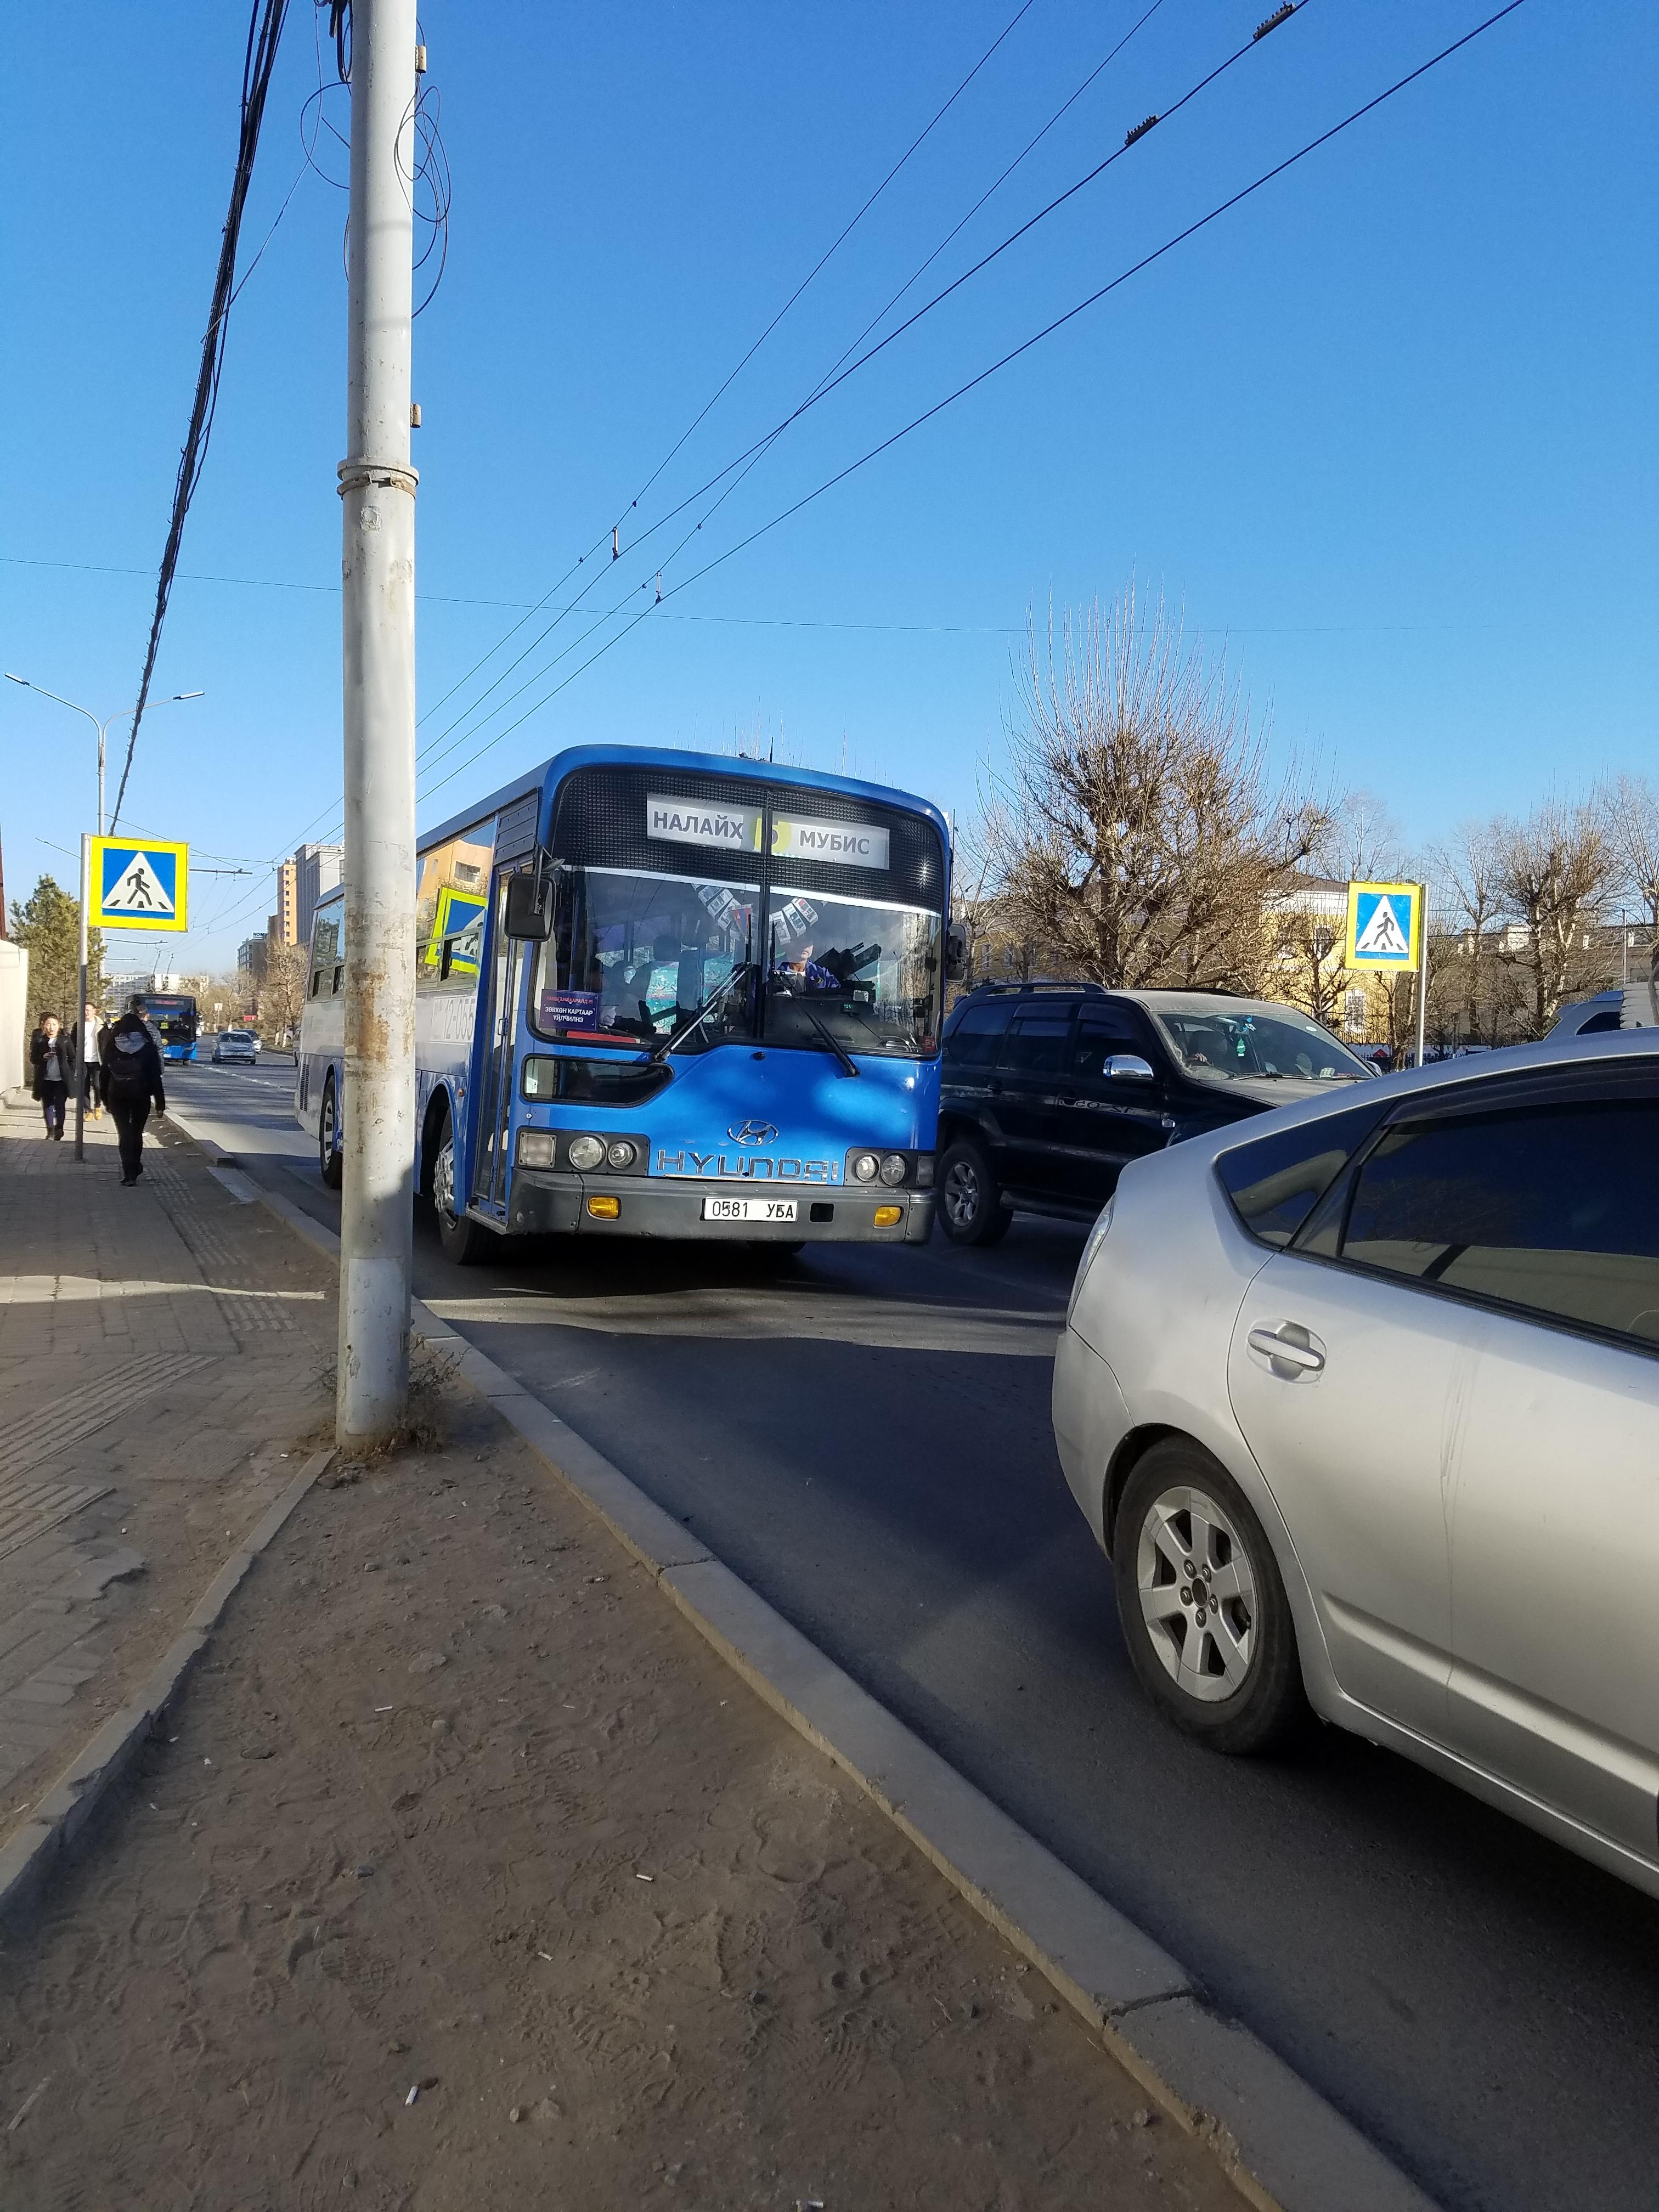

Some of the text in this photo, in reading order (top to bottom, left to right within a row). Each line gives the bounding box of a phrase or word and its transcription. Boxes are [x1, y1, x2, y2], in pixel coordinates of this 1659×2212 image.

[653, 811, 744, 839] НАЛАЙХ
[800, 830, 870, 855] МУБИС
[444, 998, 476, 1041] 12-055
[553, 1014, 584, 1023] ҮЙЛЧИЛНЭ
[658, 1150, 838, 1181] HYUNDAI
[713, 1201, 794, 1218] 0581 УБА
